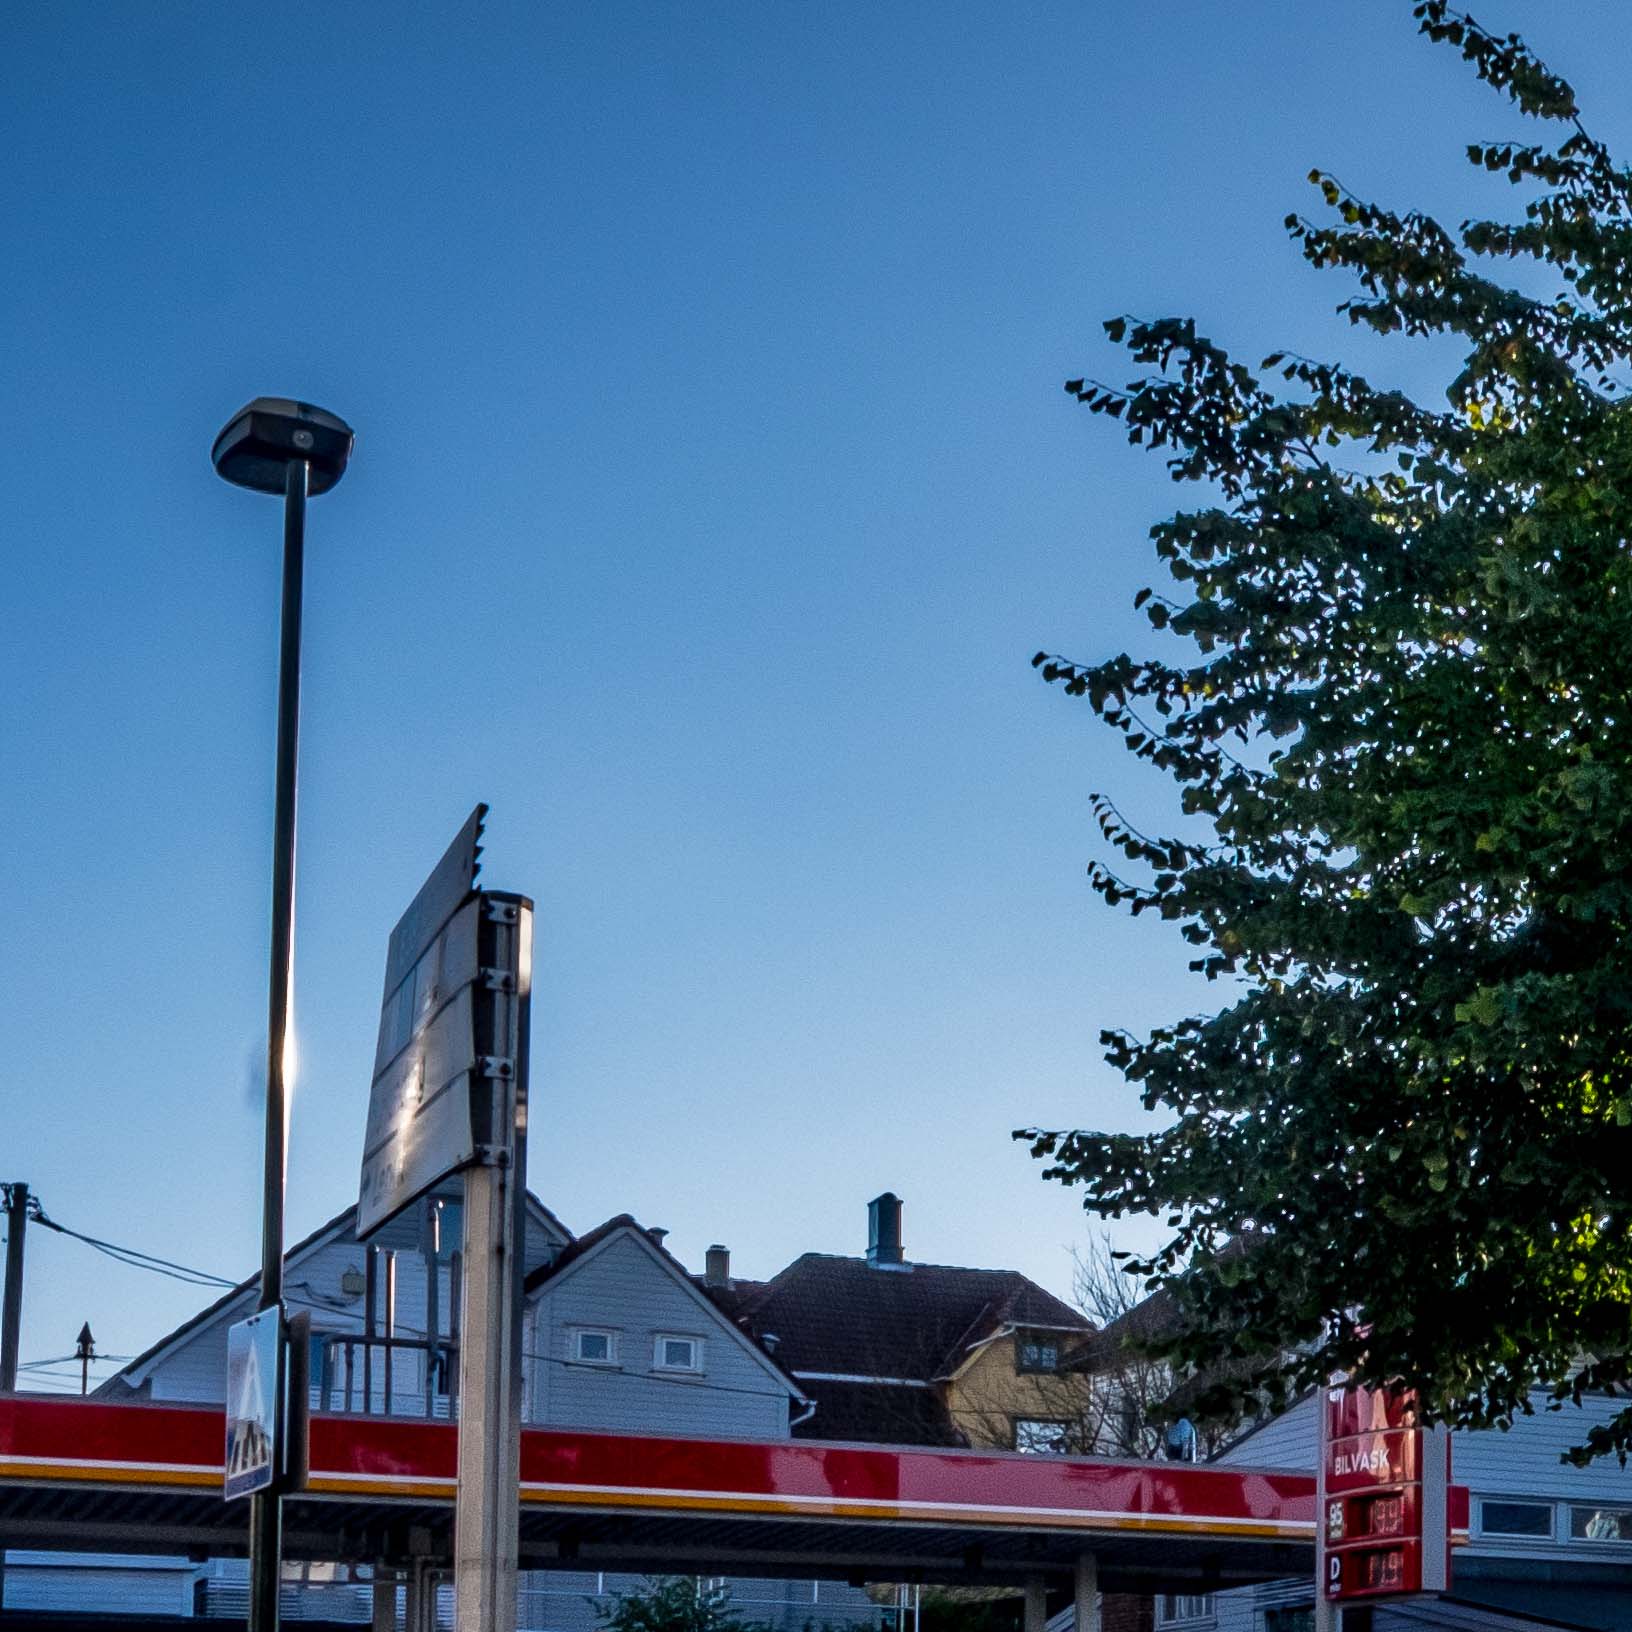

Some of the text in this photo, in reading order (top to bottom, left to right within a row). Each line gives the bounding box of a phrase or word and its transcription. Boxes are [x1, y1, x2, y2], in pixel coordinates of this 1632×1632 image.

[1335, 1448, 1389, 1476] BILVASK
[1330, 1502, 1343, 1527] 95
[1331, 1557, 1340, 1580] D
